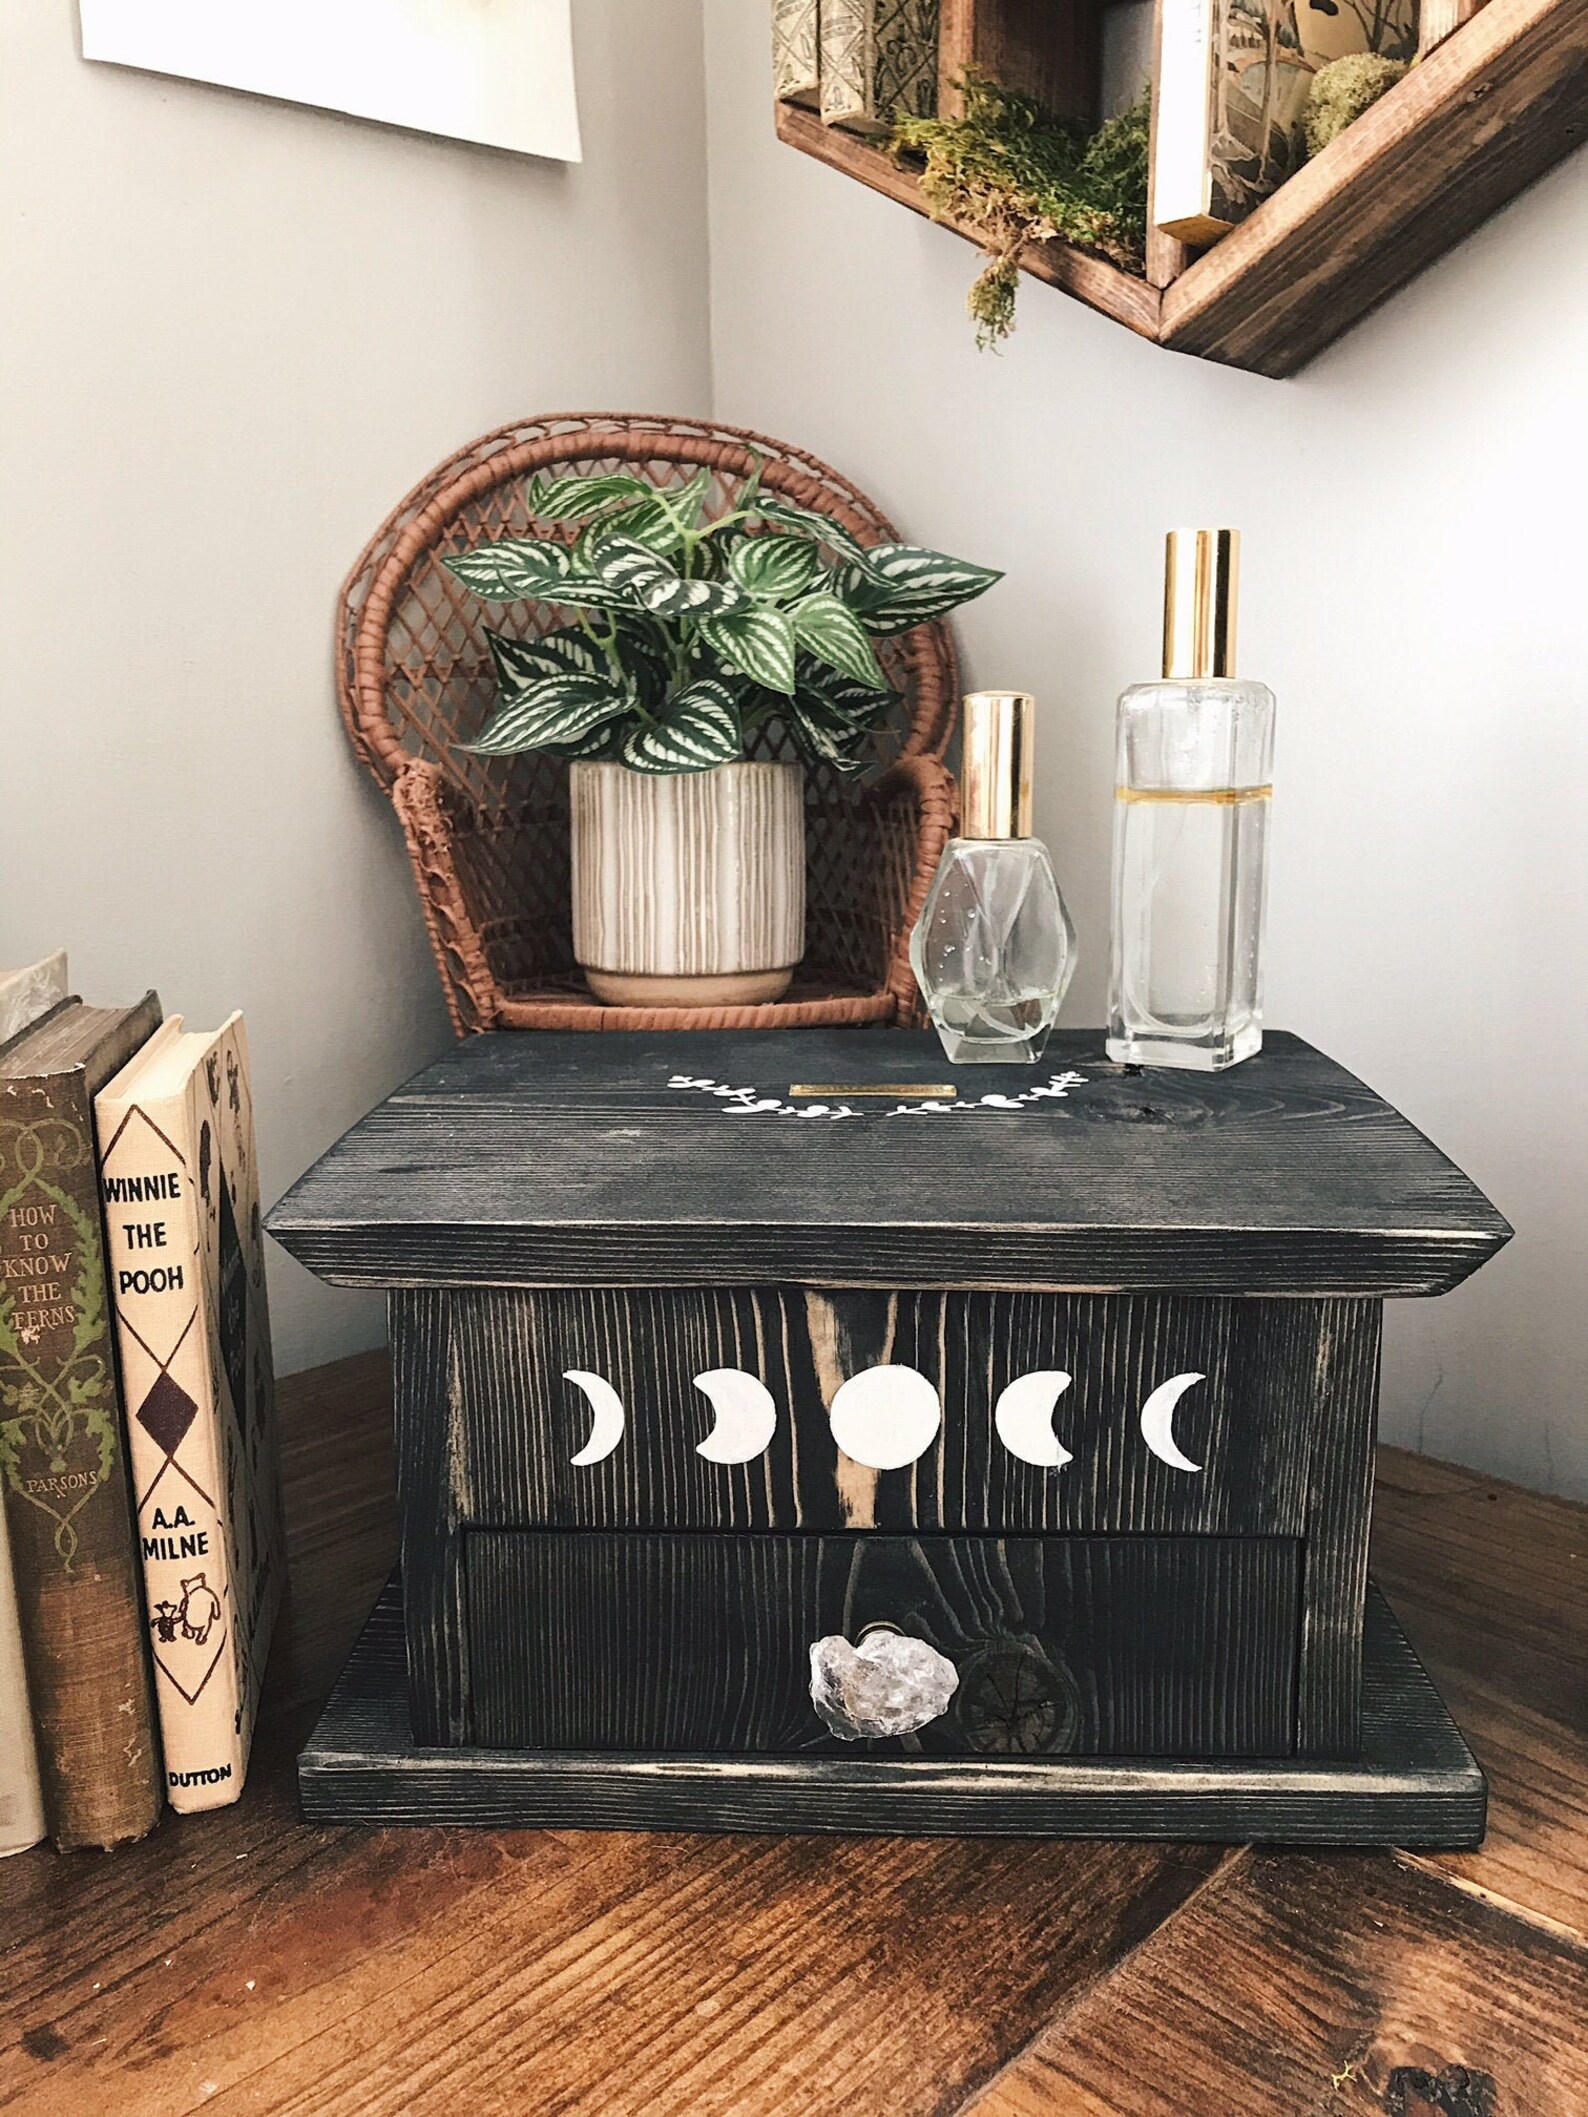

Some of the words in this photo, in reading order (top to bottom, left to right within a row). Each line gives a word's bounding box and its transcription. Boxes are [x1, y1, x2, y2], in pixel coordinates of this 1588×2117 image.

[103, 1173, 181, 1203] WINNIE
[10, 1204, 57, 1228] HOW
[19, 1233, 49, 1251] TO
[122, 1222, 167, 1249] THE
[3, 1252, 72, 1278] KNOW
[18, 1282, 61, 1303] THE
[119, 1265, 184, 1294] POOH
[12, 1305, 76, 1330] FERNS
[26, 1470, 97, 1497] PARSONS
[142, 1532, 209, 1560] MILNE
[169, 1762, 232, 1787] DUTTON
